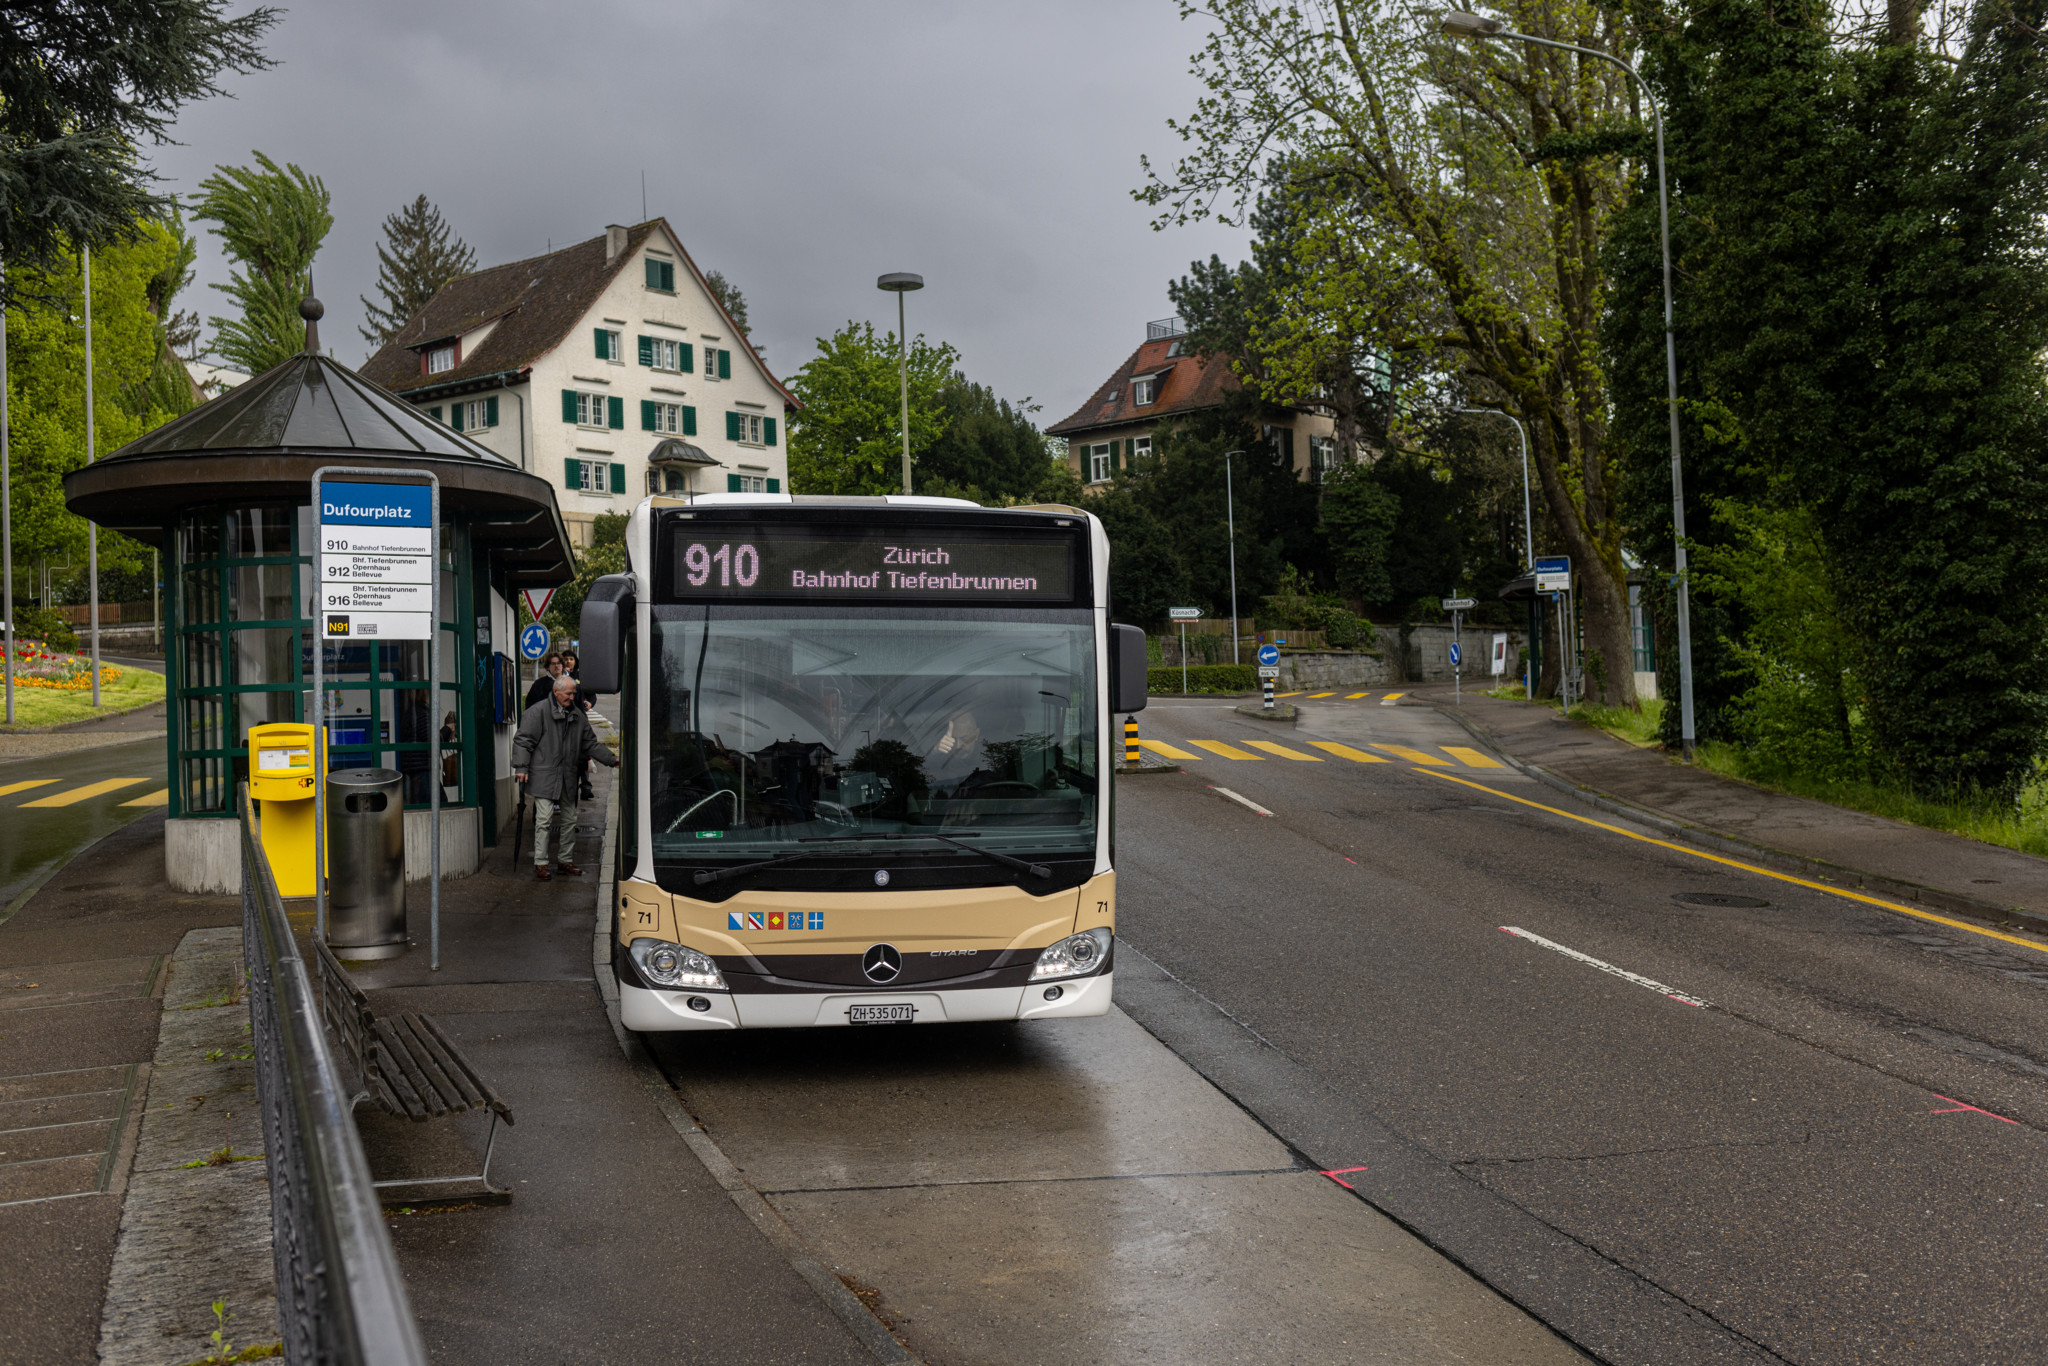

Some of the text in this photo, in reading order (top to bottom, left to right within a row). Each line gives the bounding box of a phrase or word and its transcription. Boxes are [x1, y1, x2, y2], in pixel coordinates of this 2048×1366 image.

[323, 503, 412, 520] Dufourplatz
[327, 540, 426, 553] 910 Bahnhof Tiefenbrunnen
[352, 556, 417, 565] Bhf. Tiefenbrunnen
[883, 547, 950, 565] Zürich
[352, 564, 391, 572] Opernhaus
[684, 543, 759, 587] 910
[328, 566, 350, 577] 912
[792, 570, 1037, 590] Bahnhof Tiefenbrunnen
[328, 595, 350, 606] 916
[352, 593, 391, 601] Opernhaus
[328, 622, 349, 632] N91
[302, 653, 345, 662] Dufrplatz
[1096, 901, 1108, 913] 71
[637, 911, 651, 924] 71
[930, 949, 977, 957] CITARO
